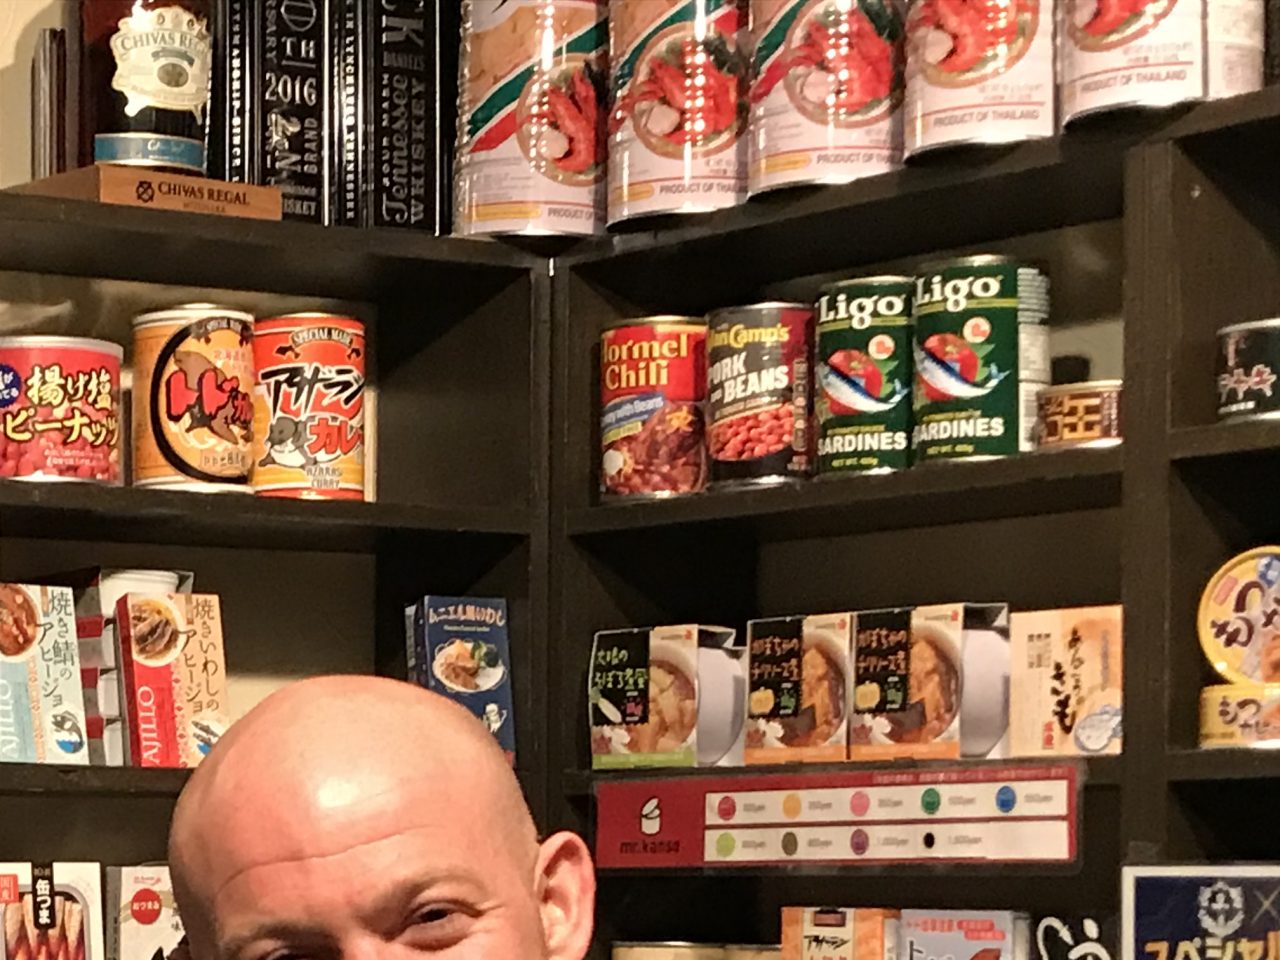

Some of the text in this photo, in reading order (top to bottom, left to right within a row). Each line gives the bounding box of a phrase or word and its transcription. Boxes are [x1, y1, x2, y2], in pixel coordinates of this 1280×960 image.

[121, 28, 177, 52] CHIVAS
[264, 72, 317, 106] 2016
[381, 73, 409, 224] Tennessee
[410, 77, 426, 225] WHISKEY
[157, 181, 249, 206] CHIVAS REGAL
[818, 293, 905, 330] Ligo
[916, 273, 1003, 313] Ligo
[729, 324, 792, 348] Camp's
[26, 365, 113, 411] 揚げ塩
[605, 360, 669, 390] Chili
[723, 365, 790, 404] BEANS
[5, 408, 119, 446] ピーナッツ
[194, 598, 221, 713] 焼きいわしの
[136, 685, 162, 765] AJILLO
[35, 878, 52, 925] 缶つま
